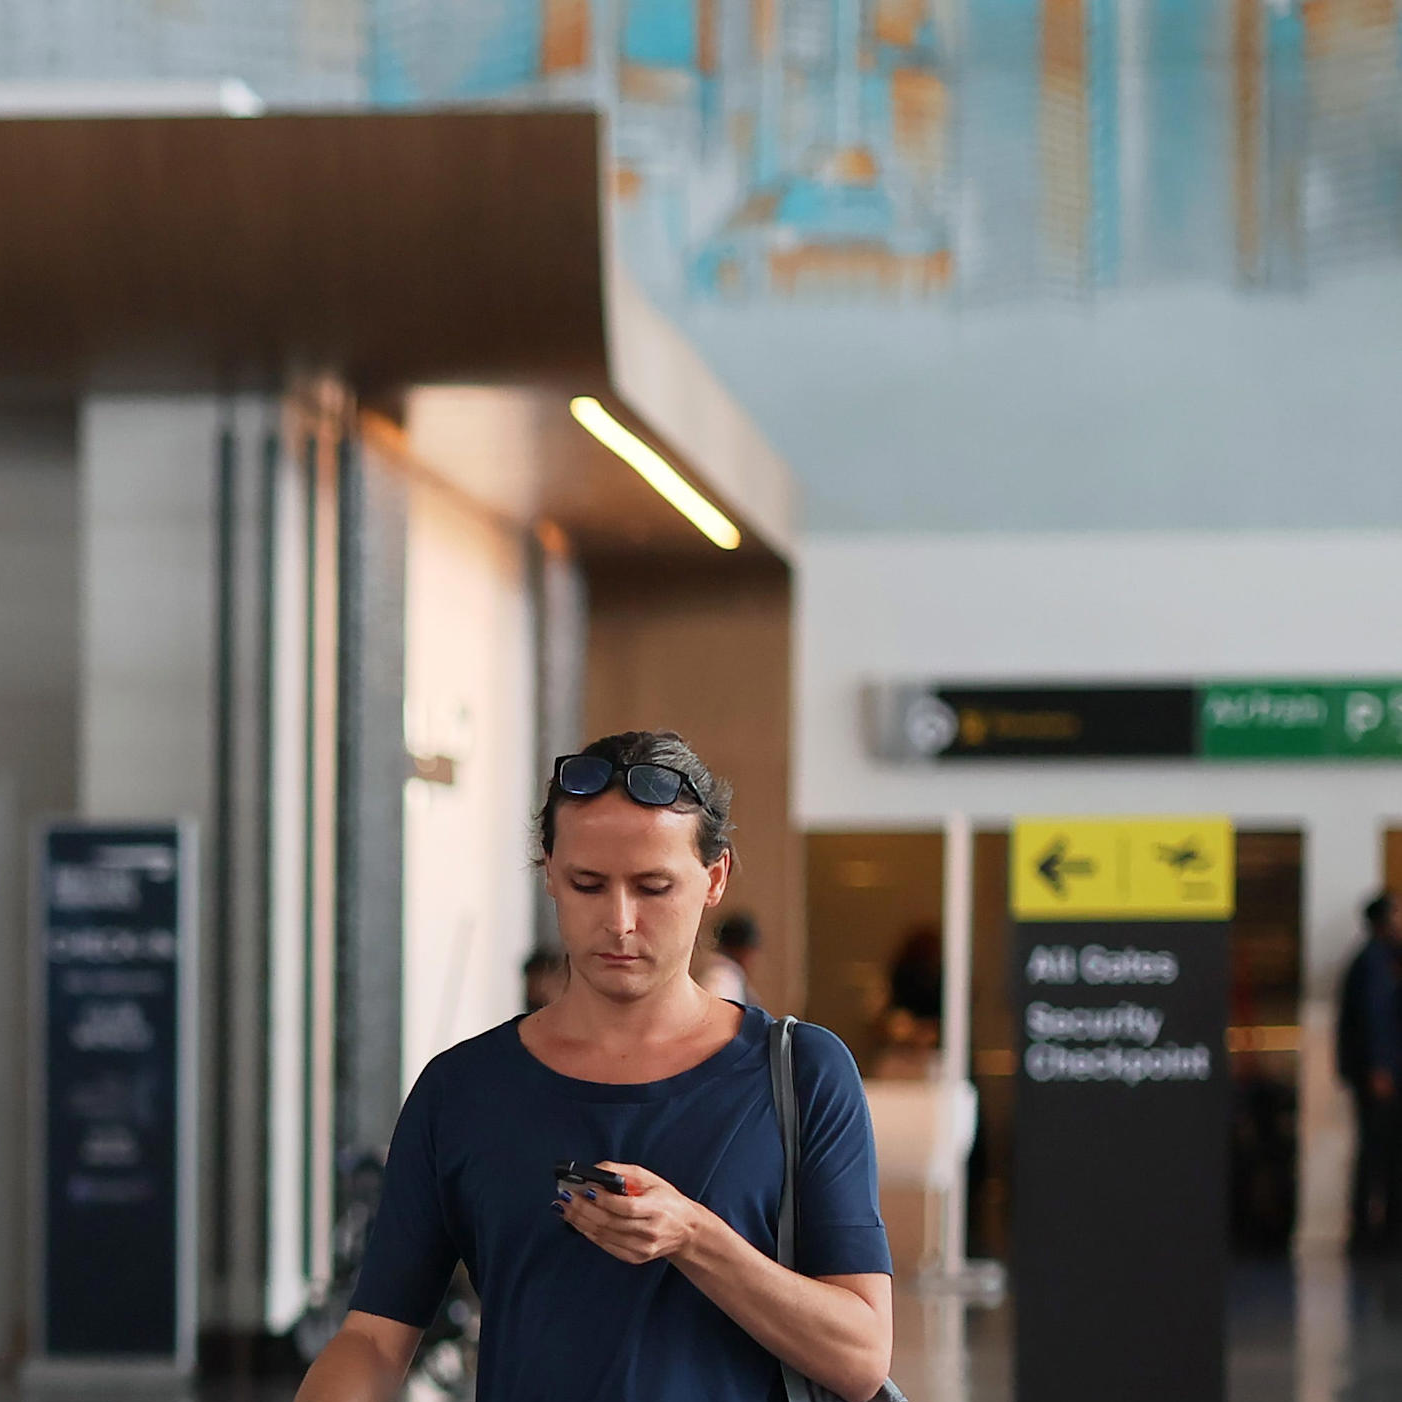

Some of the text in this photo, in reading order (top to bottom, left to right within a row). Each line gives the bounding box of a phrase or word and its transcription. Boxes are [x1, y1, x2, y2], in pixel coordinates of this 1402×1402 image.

[1027, 945, 1178, 984] All Gates
[1027, 1002, 1163, 1046] Security
[1026, 1042, 1210, 1087] Checkpoint
